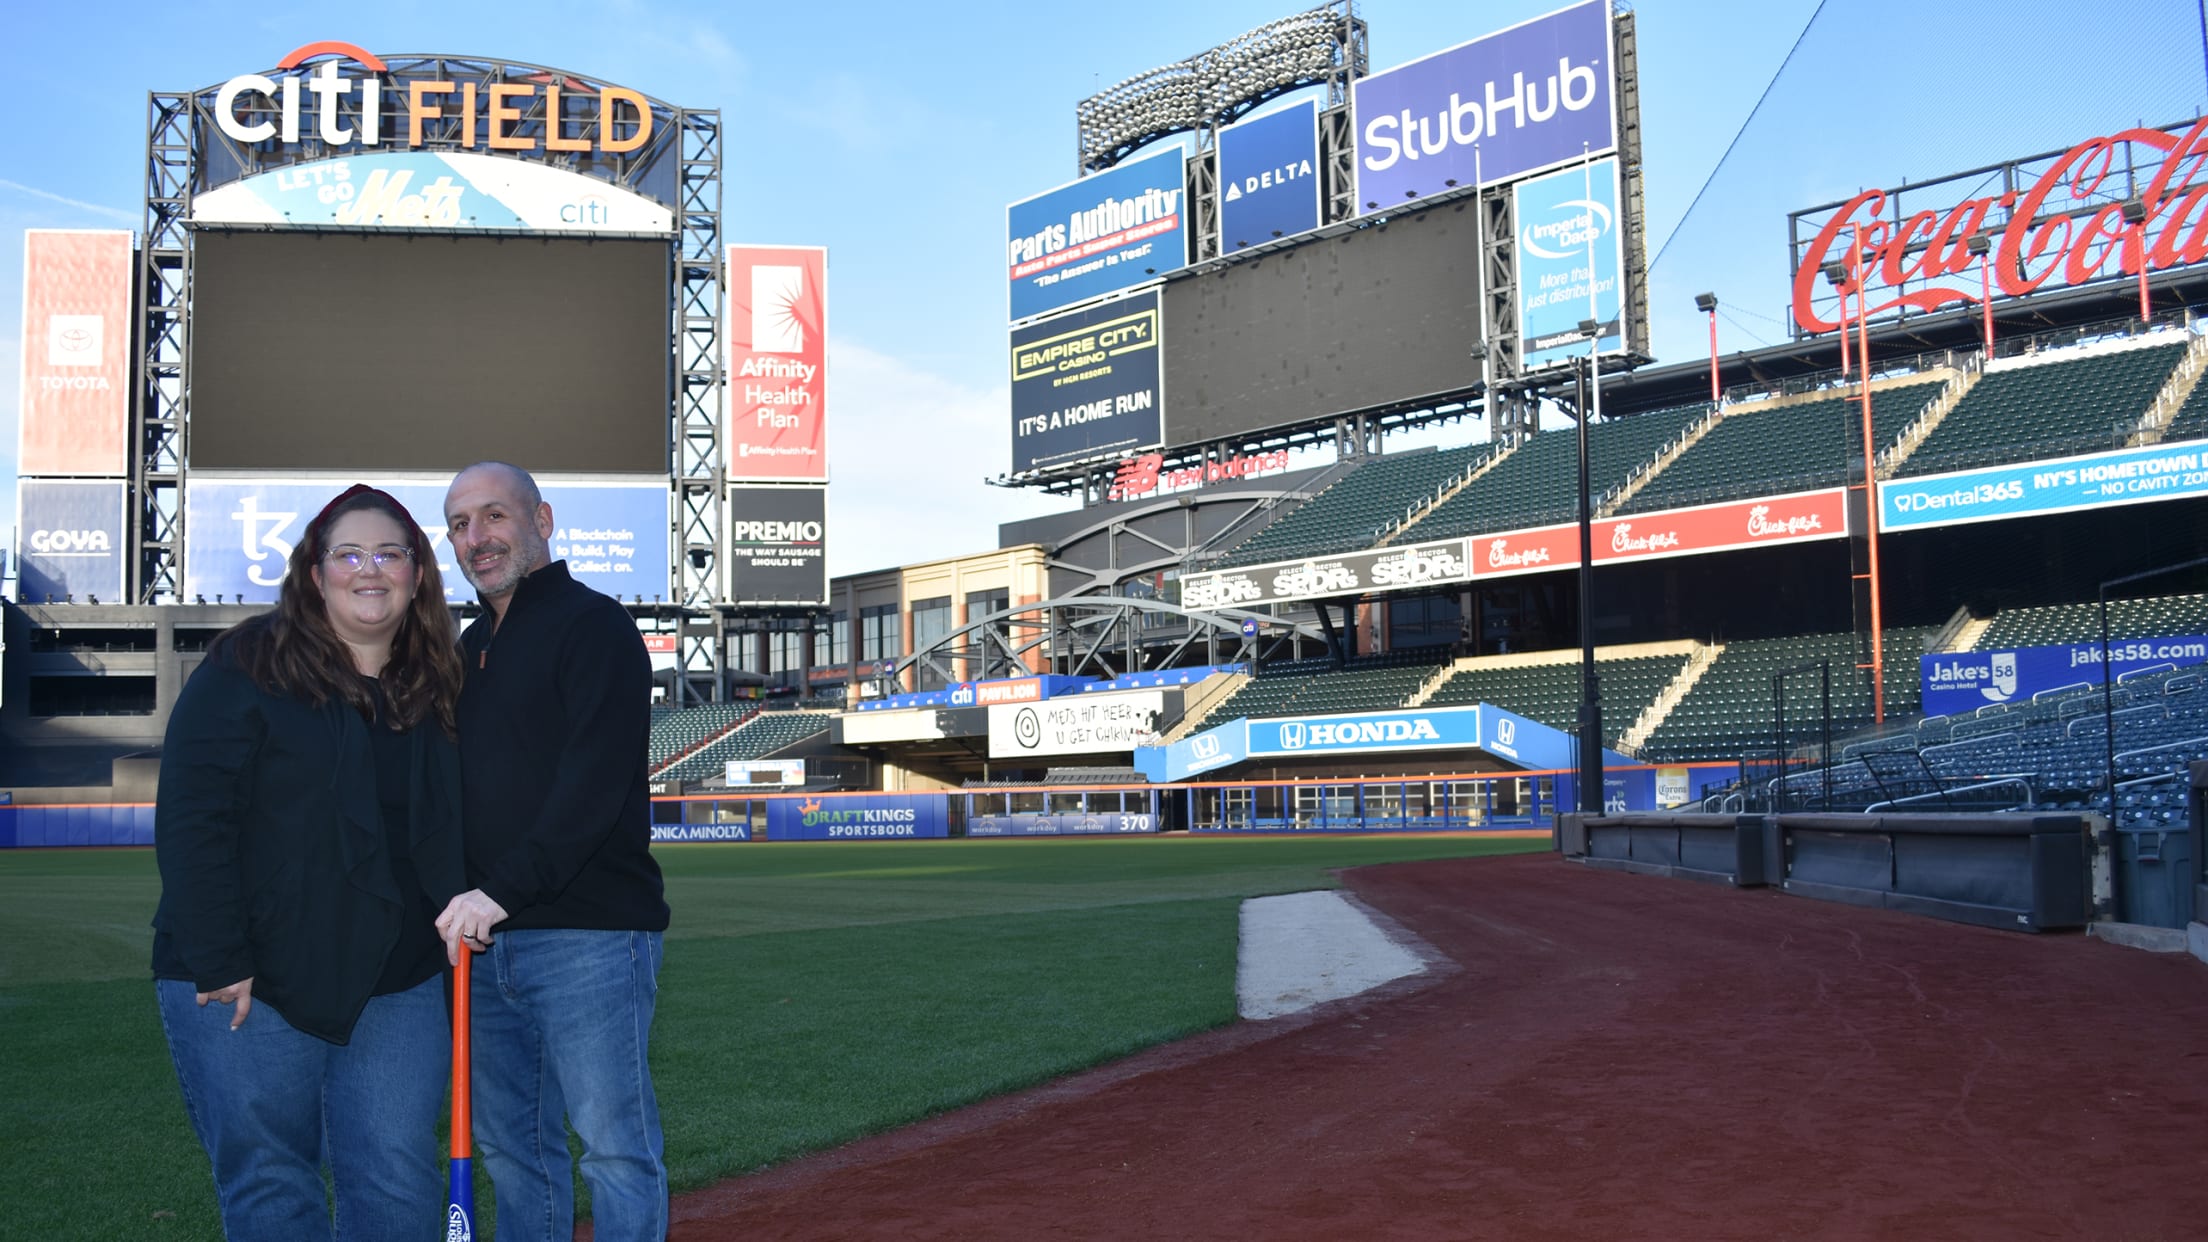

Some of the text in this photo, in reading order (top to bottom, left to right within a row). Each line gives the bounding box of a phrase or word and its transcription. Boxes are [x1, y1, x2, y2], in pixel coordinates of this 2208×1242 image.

[214, 59, 653, 153] citi FIELD
[1364, 56, 1597, 171] StubHub
[276, 161, 352, 192] LET'S
[1245, 159, 1313, 194] DELTA
[317, 181, 355, 205] GO
[335, 168, 465, 227] Mets
[559, 200, 608, 225] citi
[1009, 187, 1178, 266] Parts Authority
[1534, 213, 1592, 239] Imperia
[1793, 114, 2208, 333] Coca-Cola
[1014, 218, 1174, 277] Auto Parts Super Stores
[1060, 258, 1105, 281] Answer
[1539, 266, 1592, 290] More tha
[1526, 291, 1548, 312] just
[1020, 336, 1096, 370] EMPIRE
[1058, 351, 1106, 372] CASINO
[740, 357, 816, 383] Affinity
[1080, 365, 1113, 382] RESORTS
[40, 376, 110, 391] TOYOTA
[745, 384, 811, 405] Health
[757, 408, 800, 429] Plan
[1019, 389, 1152, 438] IT'S A HOME RUN
[748, 445, 817, 457] Affinity Health Plan
[1166, 465, 1204, 489] new
[1207, 449, 1289, 482] balance
[2033, 468, 2078, 490] NY'S
[2080, 453, 2198, 484] HOMETOWN
[1912, 480, 2024, 511] Dental365
[2101, 482, 2125, 496] NO
[2127, 474, 2180, 492] CAVITY
[31, 529, 111, 552] GOYA
[556, 528, 634, 541] A Blockchain
[735, 520, 822, 541] PREMIO
[555, 544, 635, 560] to Build, Play
[734, 548, 821, 557] THE WAY SAUSAGE
[751, 558, 790, 567] SHOULD
[1378, 548, 1447, 563] SELECT SECTOR
[568, 560, 633, 573] Collect on.
[1279, 561, 1343, 575] SELECT SECTOR
[1189, 574, 1247, 588] SELECT SECTOR
[2070, 643, 2205, 668] jakes58.com
[1928, 661, 2014, 682] Jake's 58
[952, 687, 973, 705] citi
[979, 683, 1037, 701] PAVILION
[1930, 683, 1955, 691] Casino
[1048, 707, 1076, 725] METS
[1081, 705, 1098, 720] HIT
[1055, 725, 1132, 744] U GET CHIKIN
[1308, 719, 1440, 745] HONDA
[802, 809, 915, 827] DRAFTKINGS
[1073, 823, 1103, 832] workday
[1119, 815, 1149, 831] 370
[650, 825, 746, 840] ONICA MINOLTA
[829, 824, 914, 836] SPORTSBOOK
[972, 826, 1002, 834] workday
[447, 1210, 462, 1242] Slug
